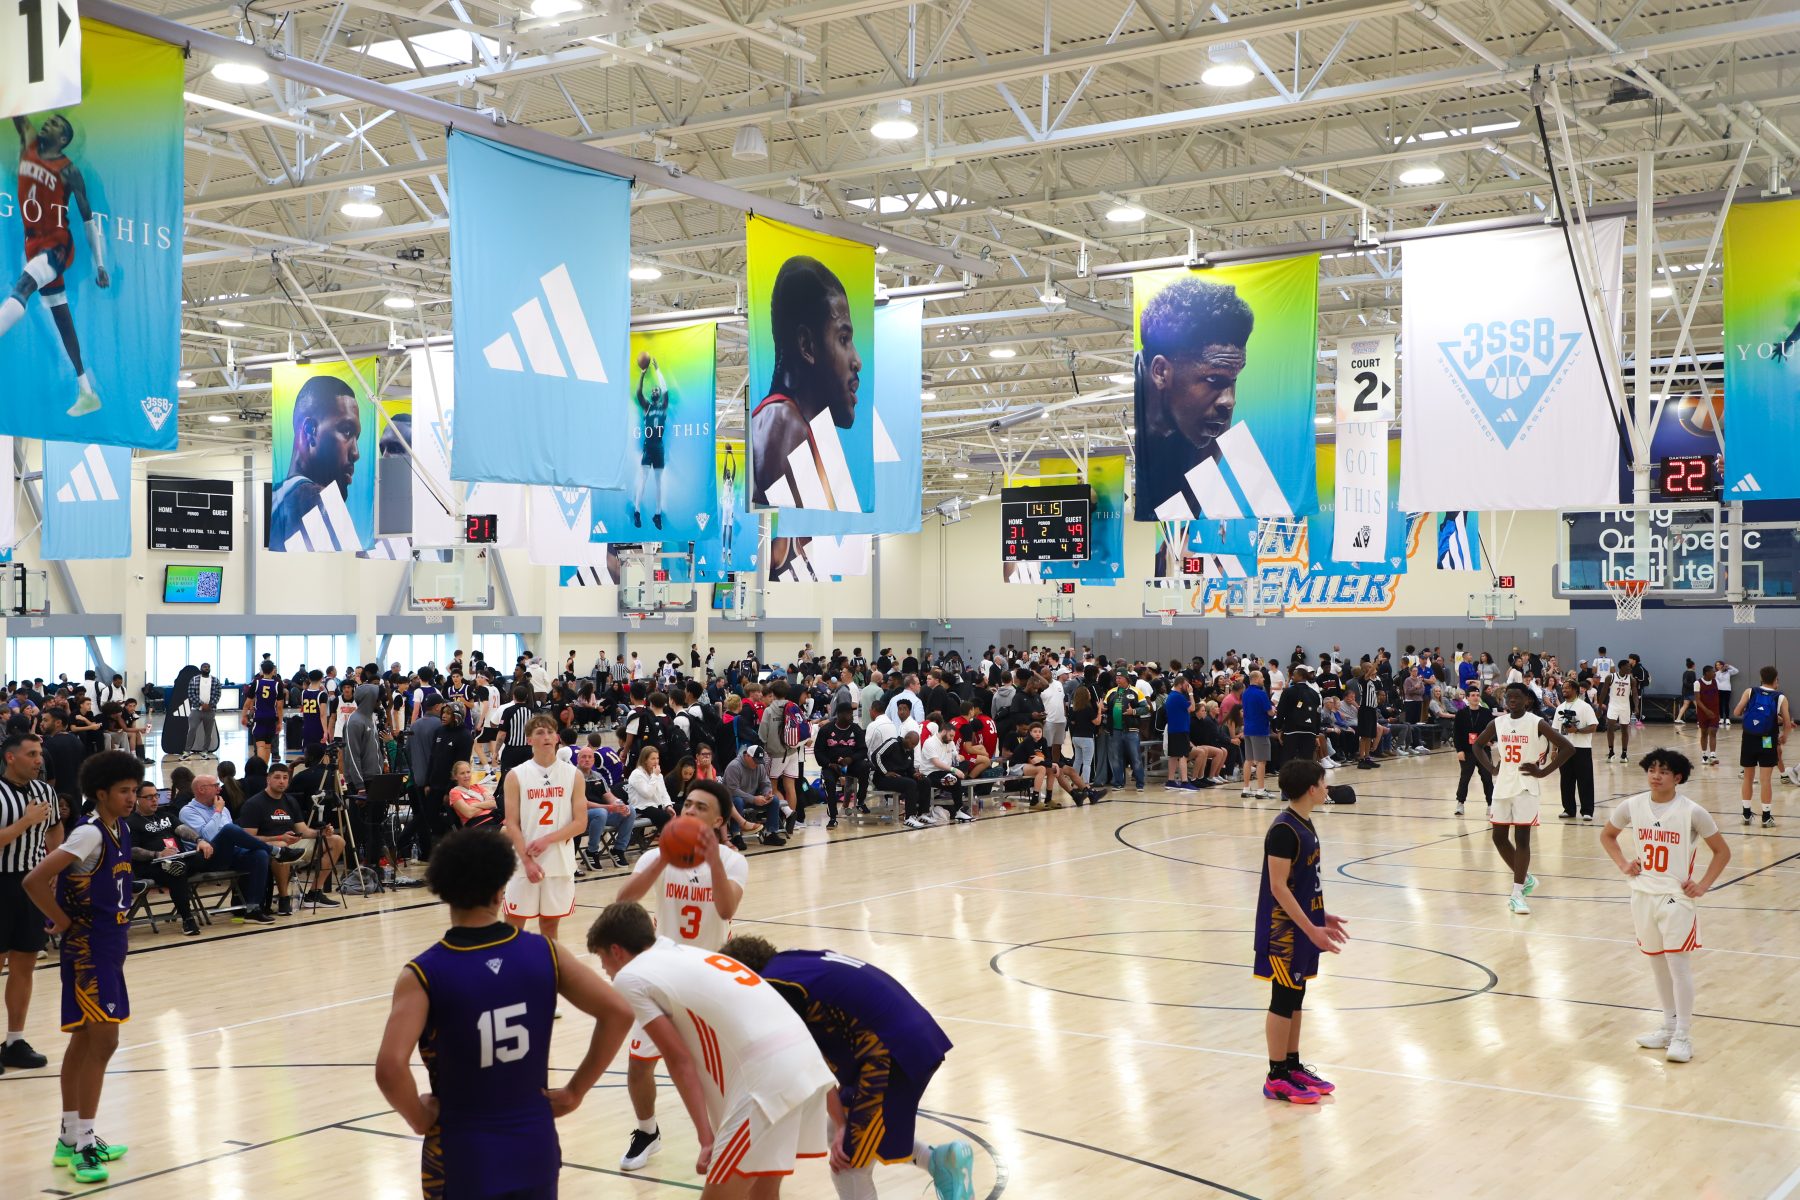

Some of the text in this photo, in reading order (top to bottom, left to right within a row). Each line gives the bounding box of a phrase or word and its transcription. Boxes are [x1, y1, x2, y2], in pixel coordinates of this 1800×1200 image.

[19, 0, 44, 84] 1
[92, 211, 171, 249] THIS
[1463, 317, 1555, 371] 3SSB
[1736, 341, 1796, 361] YOU
[1351, 358, 1381, 369] COURT
[1353, 371, 1379, 412] 2
[633, 422, 710, 439] GOT THIS
[1345, 448, 1379, 476] GOT
[1667, 461, 1706, 492] 22
[158, 506, 173, 514] HOME
[1032, 502, 1061, 516] 14:15
[1342, 487, 1381, 515] THIS
[1008, 516, 1083, 526] HOME GUEST
[1095, 511, 1121, 519] THIS
[468, 518, 489, 539] 21
[1010, 523, 1083, 539] 31 2 49
[1009, 543, 1083, 555] 0 4 4 2
[1599, 528, 1761, 556] Orhopec
[1186, 559, 1200, 572] 30
[1601, 557, 1714, 583] Insitute
[1500, 577, 1513, 587] 30
[262, 686, 271, 699] 5
[1616, 687, 1626, 697] 22
[303, 699, 317, 713] 22
[1504, 745, 1522, 763] 35
[527, 788, 545, 800] IOWA
[538, 800, 554, 826] 2
[1653, 829, 1681, 845] UNITED
[1643, 843, 1669, 873] 30
[665, 882, 715, 902] IOWA UNIT
[679, 904, 703, 940] 3
[704, 954, 762, 987] 9
[477, 1001, 530, 1069] 15
